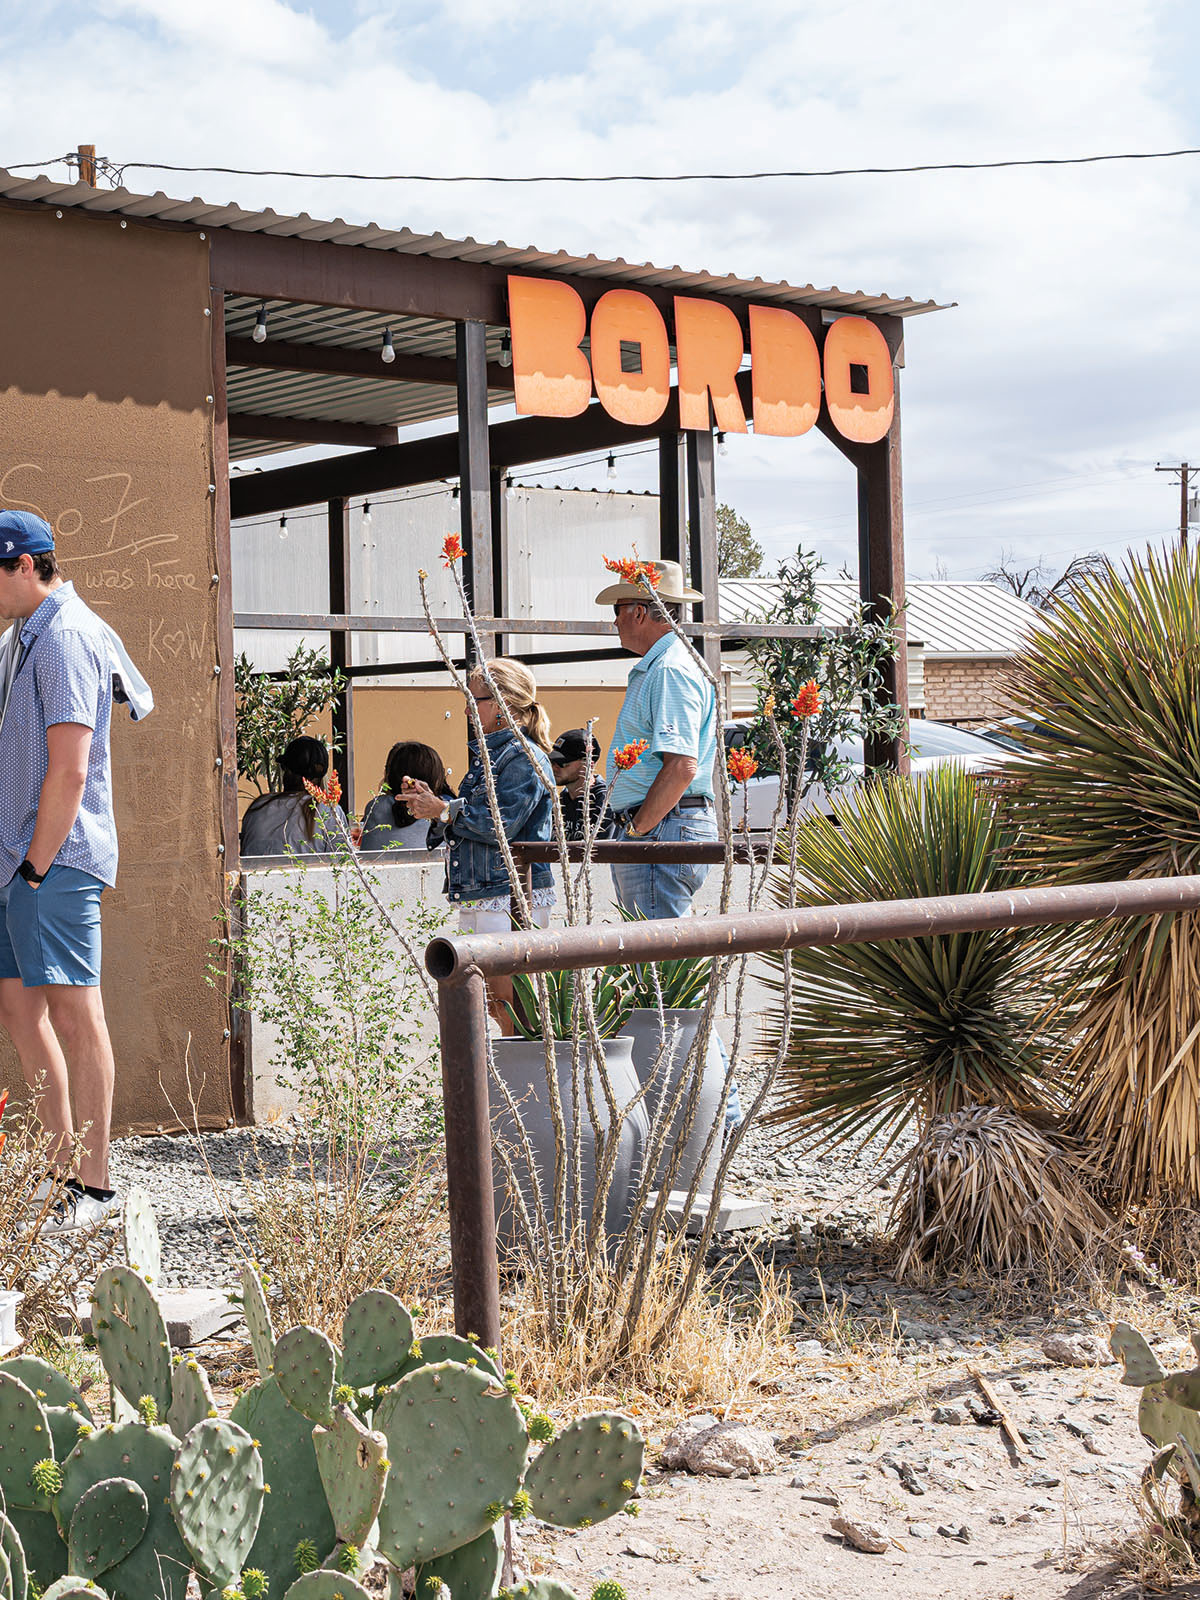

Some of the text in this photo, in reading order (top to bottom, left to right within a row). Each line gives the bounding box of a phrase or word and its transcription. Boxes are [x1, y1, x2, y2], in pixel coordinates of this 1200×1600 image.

[507, 274, 894, 444] BORDO
[85, 556, 200, 593] was here
